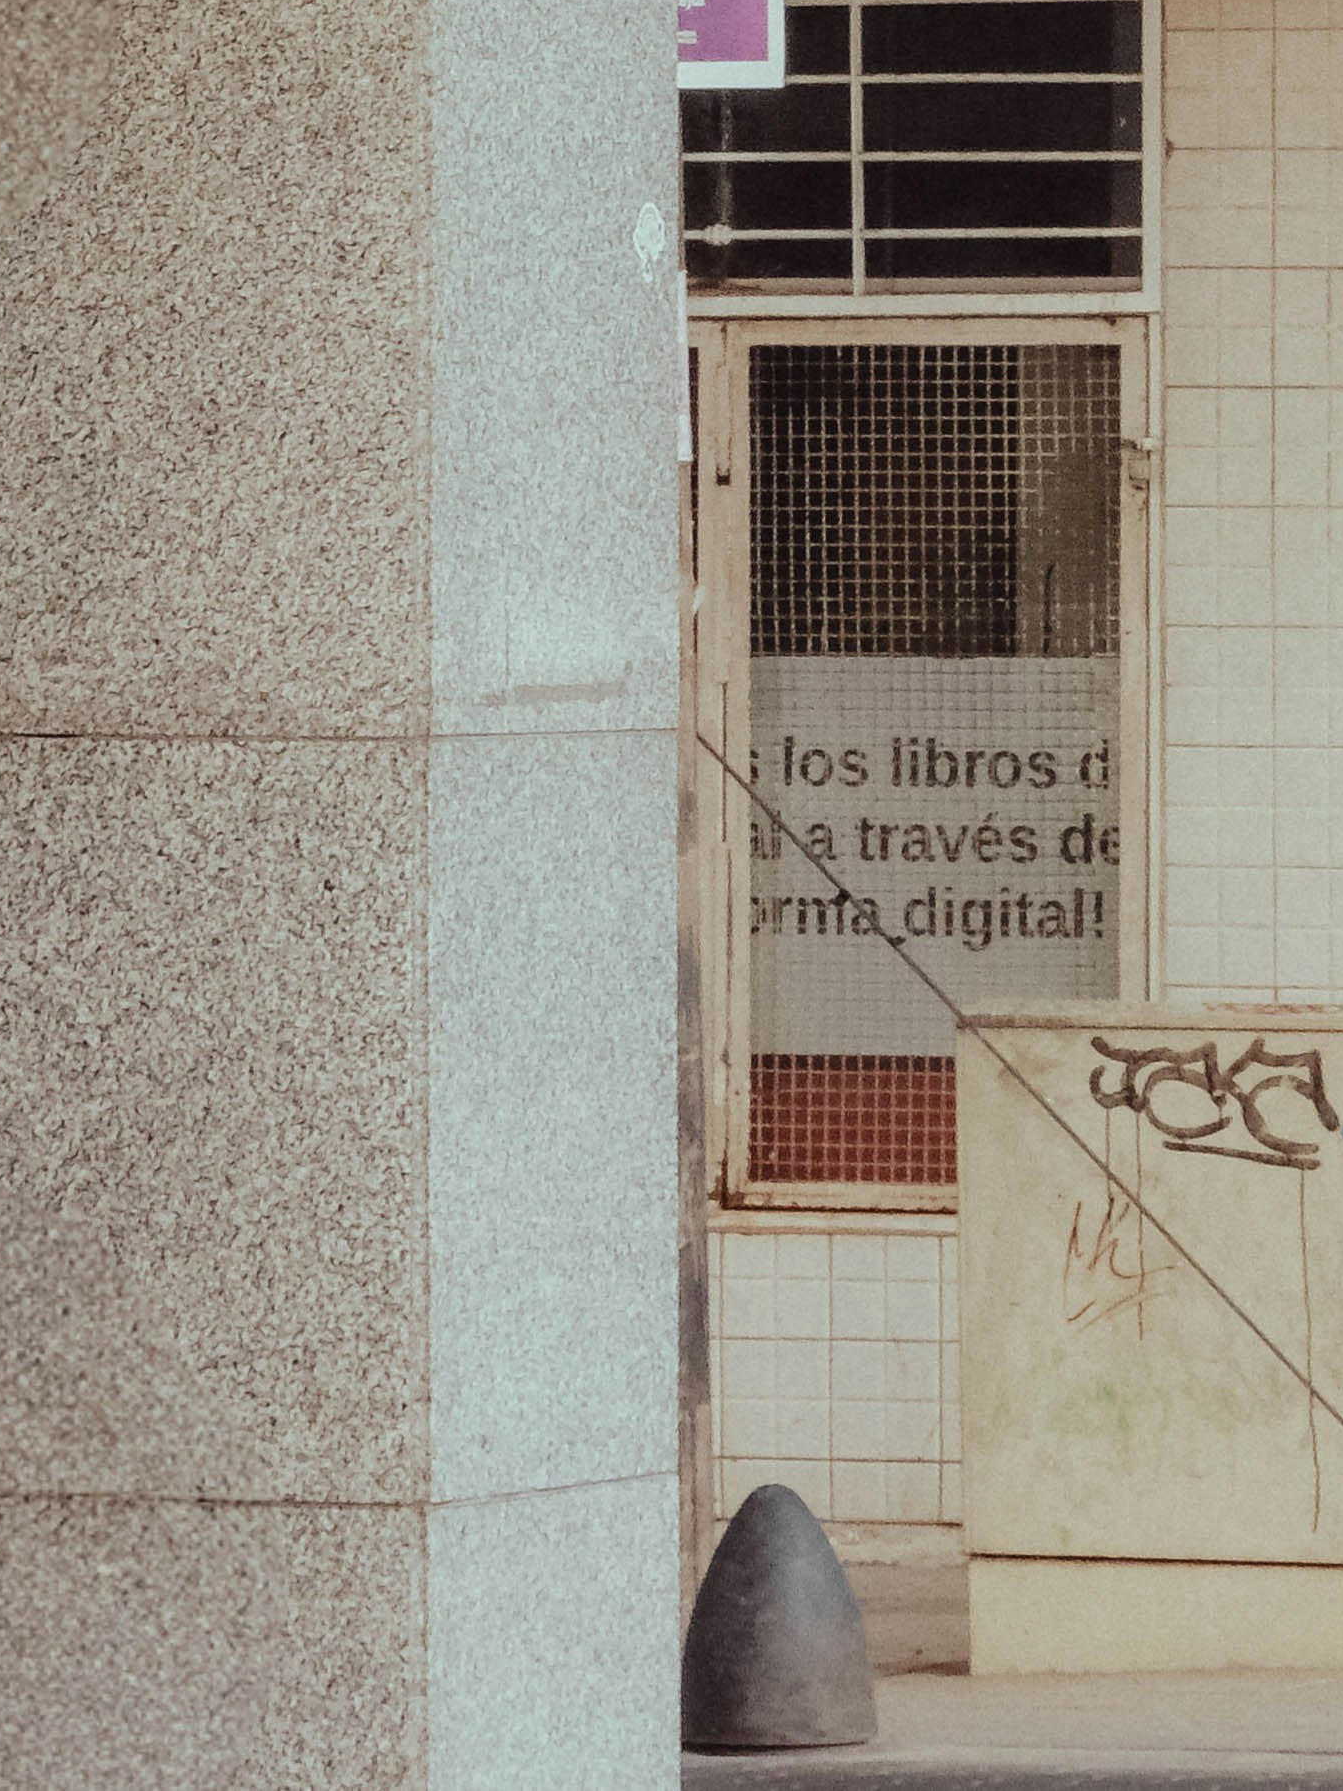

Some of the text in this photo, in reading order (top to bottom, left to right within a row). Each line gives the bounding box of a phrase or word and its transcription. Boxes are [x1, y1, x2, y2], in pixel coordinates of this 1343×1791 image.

[783, 735, 869, 787] los
[892, 736, 1057, 789] libros
[806, 822, 837, 861] a
[856, 811, 1039, 864] través
[904, 886, 1104, 952] digital!
